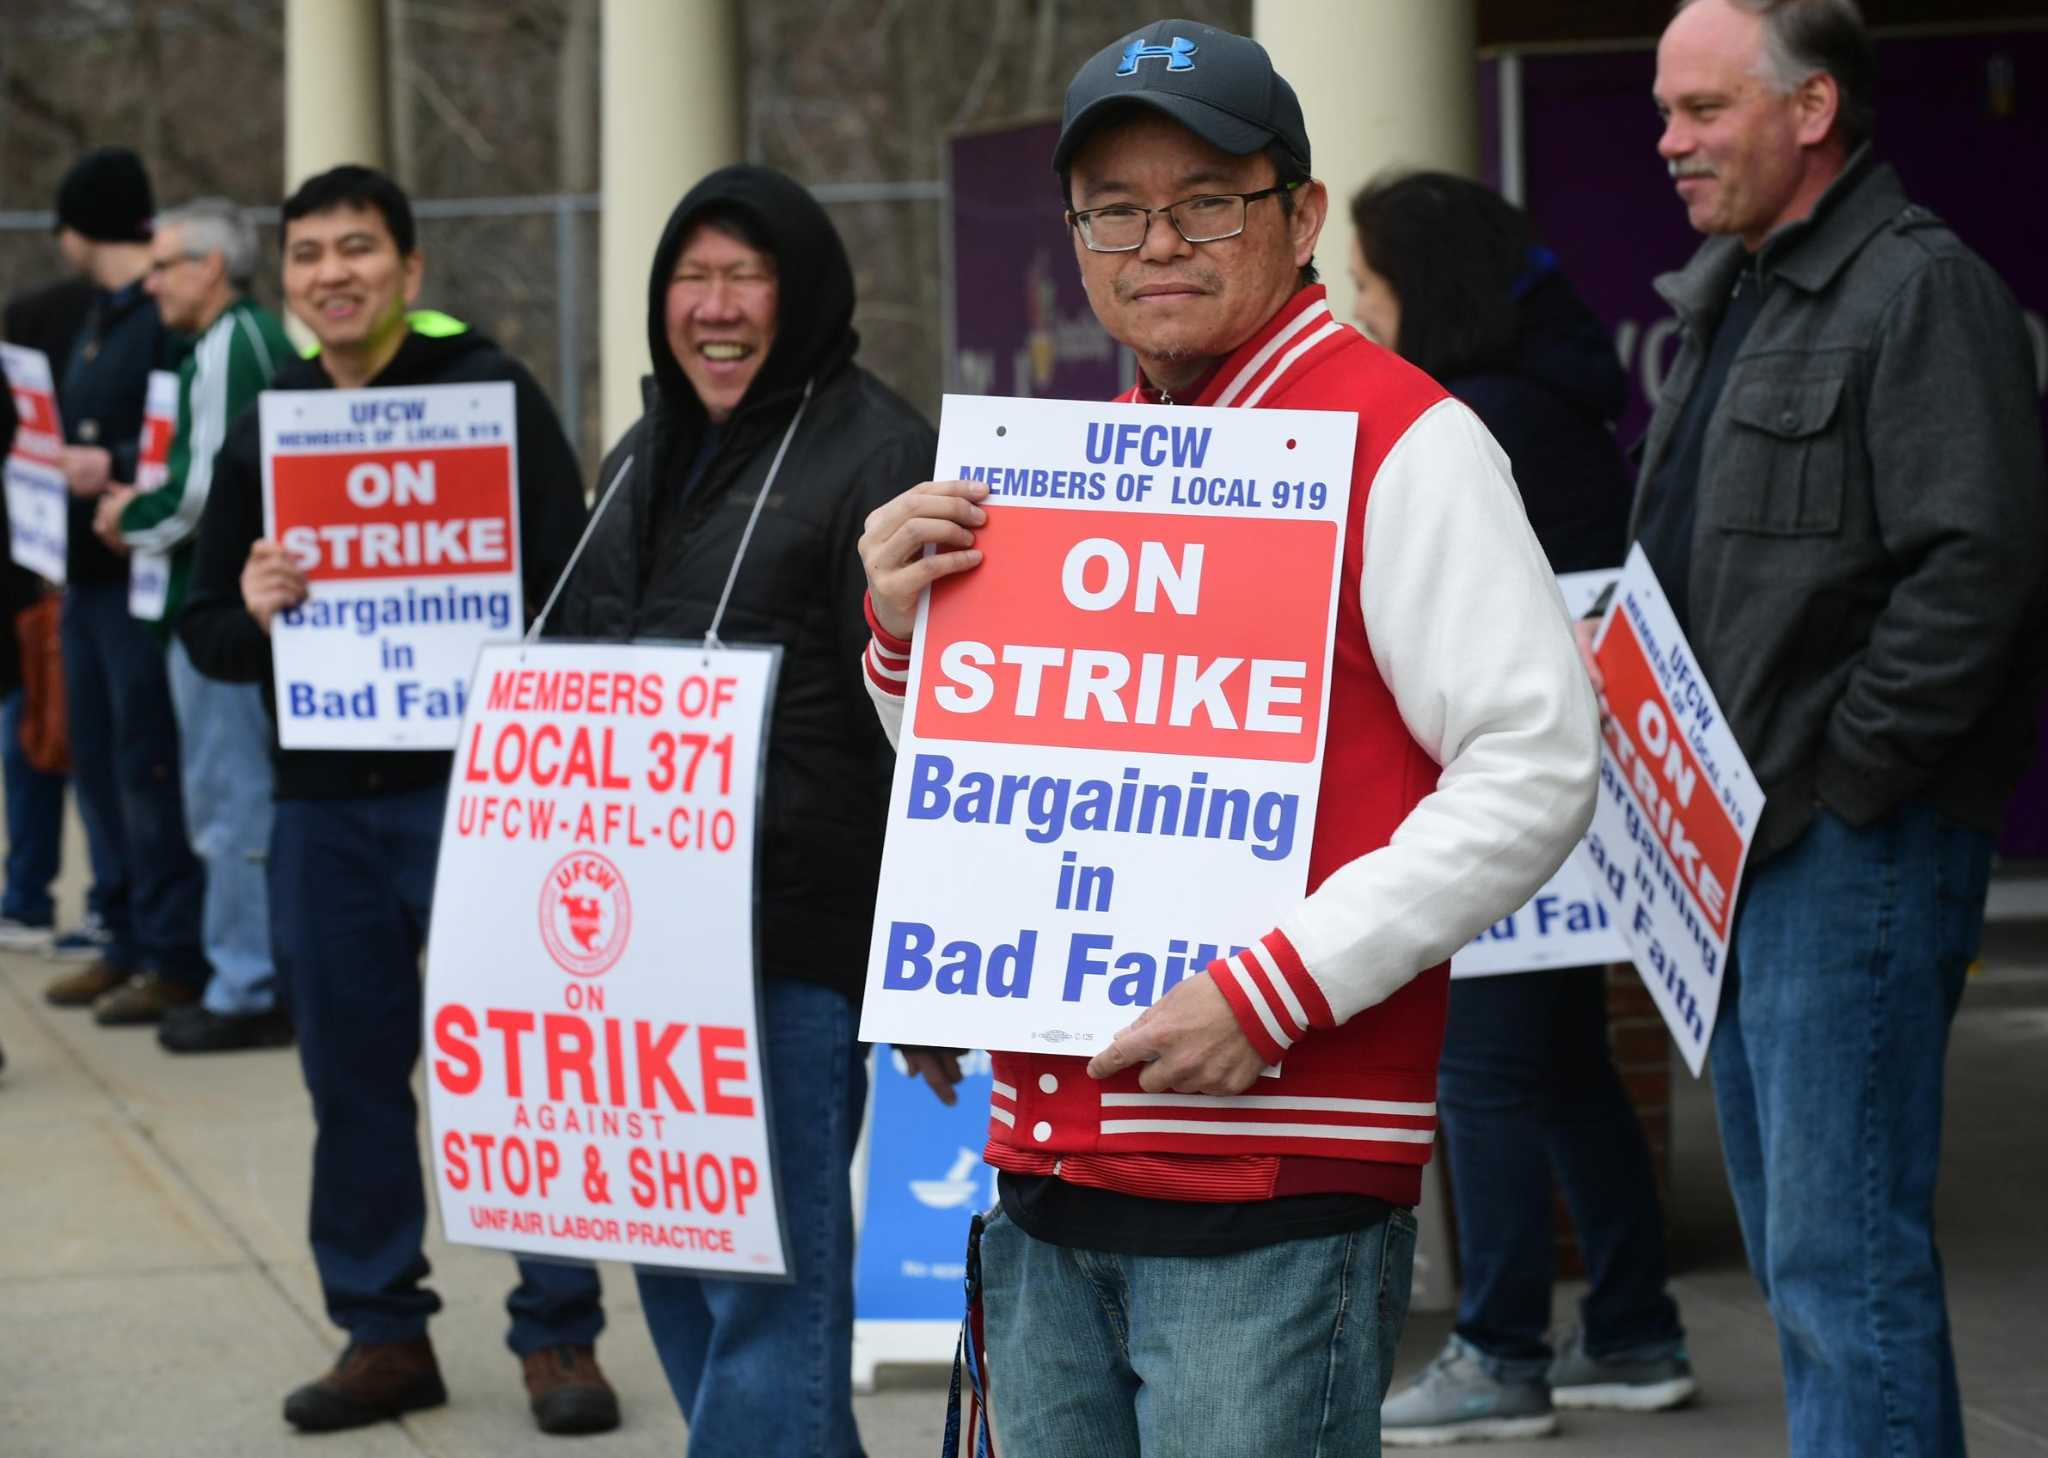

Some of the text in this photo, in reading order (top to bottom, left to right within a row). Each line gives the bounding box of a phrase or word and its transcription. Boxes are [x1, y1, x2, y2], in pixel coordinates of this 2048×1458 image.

[278, 430, 366, 446] MEMBERS
[407, 425, 460, 441] LOCAL
[350, 400, 427, 424] UFCW
[1086, 422, 1212, 469] UFCW
[346, 460, 436, 508] ON
[959, 465, 1328, 510] MEMBERS OF LOCAL 919
[283, 517, 506, 571] STRIKE
[1061, 537, 1205, 616] ON
[380, 640, 414, 669] in
[289, 680, 467, 719] Bad Fai
[486, 671, 738, 719] MEMBERS OF
[934, 640, 1307, 734] STRIKE
[1626, 591, 1673, 691] MEMBERS
[1688, 724, 1721, 785] LOCAL
[1670, 643, 1714, 732] UFCW
[465, 722, 735, 795] LOCAL 371
[1637, 699, 1697, 810] ON
[457, 795, 736, 852] UFCW-AFL-CIO
[906, 753, 1300, 861] Bargaining
[1602, 698, 1726, 926] TRIKE
[556, 860, 616, 892] UFCW
[1056, 851, 1115, 913] in
[1600, 756, 1717, 977] argaining
[1633, 855, 1655, 904] in
[1534, 894, 1608, 935] Fai
[1588, 831, 1704, 1045] ad Faith
[882, 921, 1250, 1008] Bad Fai
[563, 983, 605, 1012] ON
[434, 1003, 756, 1118] STRIKE
[513, 1103, 664, 1141] AGAINST
[443, 1130, 759, 1216] STOP & SHOP
[469, 1206, 735, 1253] UNFAIR LABOR PRACTICE
